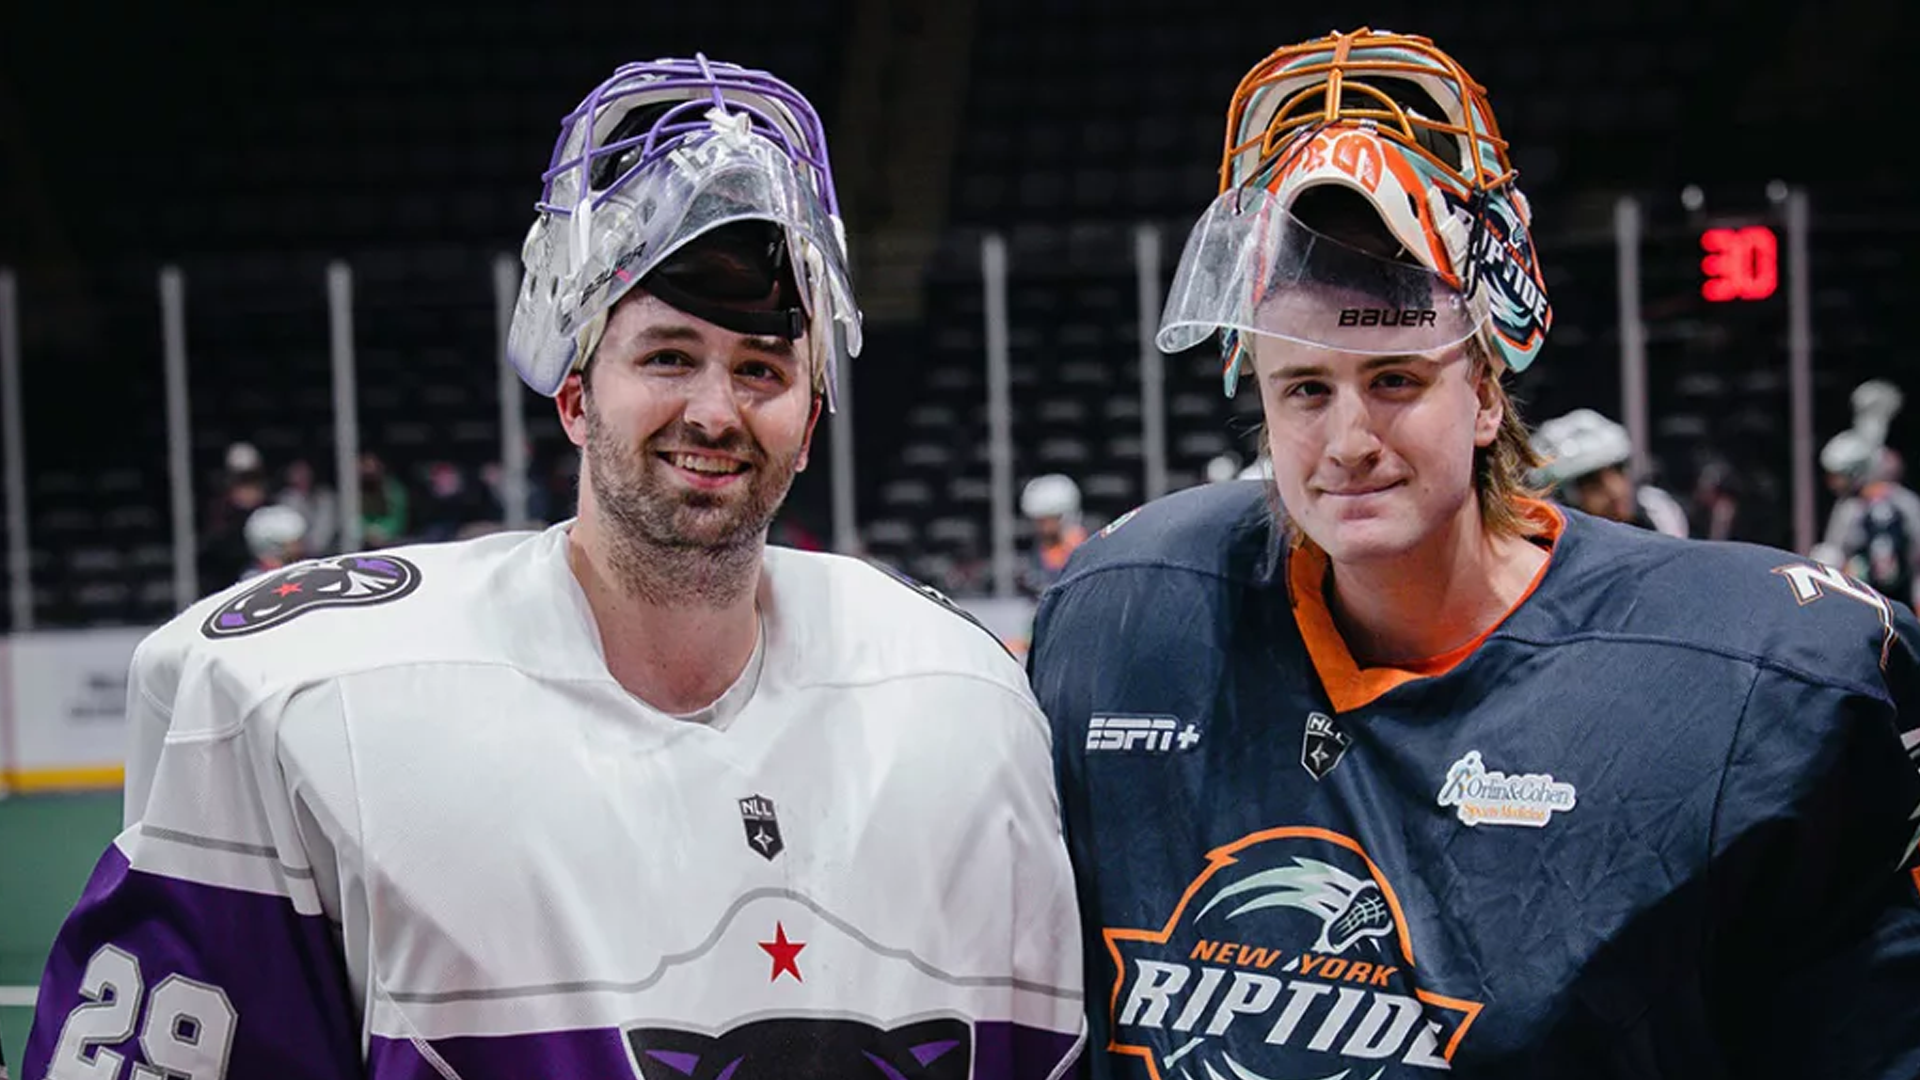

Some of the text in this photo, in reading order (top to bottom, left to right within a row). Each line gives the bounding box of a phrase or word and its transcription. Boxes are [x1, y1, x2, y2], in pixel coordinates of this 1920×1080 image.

[1473, 227, 1548, 328] IPTIDE
[1701, 226, 1777, 301] 30
[1086, 717, 1200, 751] ESPN+
[1311, 717, 1346, 746] NLL
[742, 799, 773, 816] NLL
[1190, 939, 1398, 987] NEW YORK
[49, 943, 238, 1080] 29
